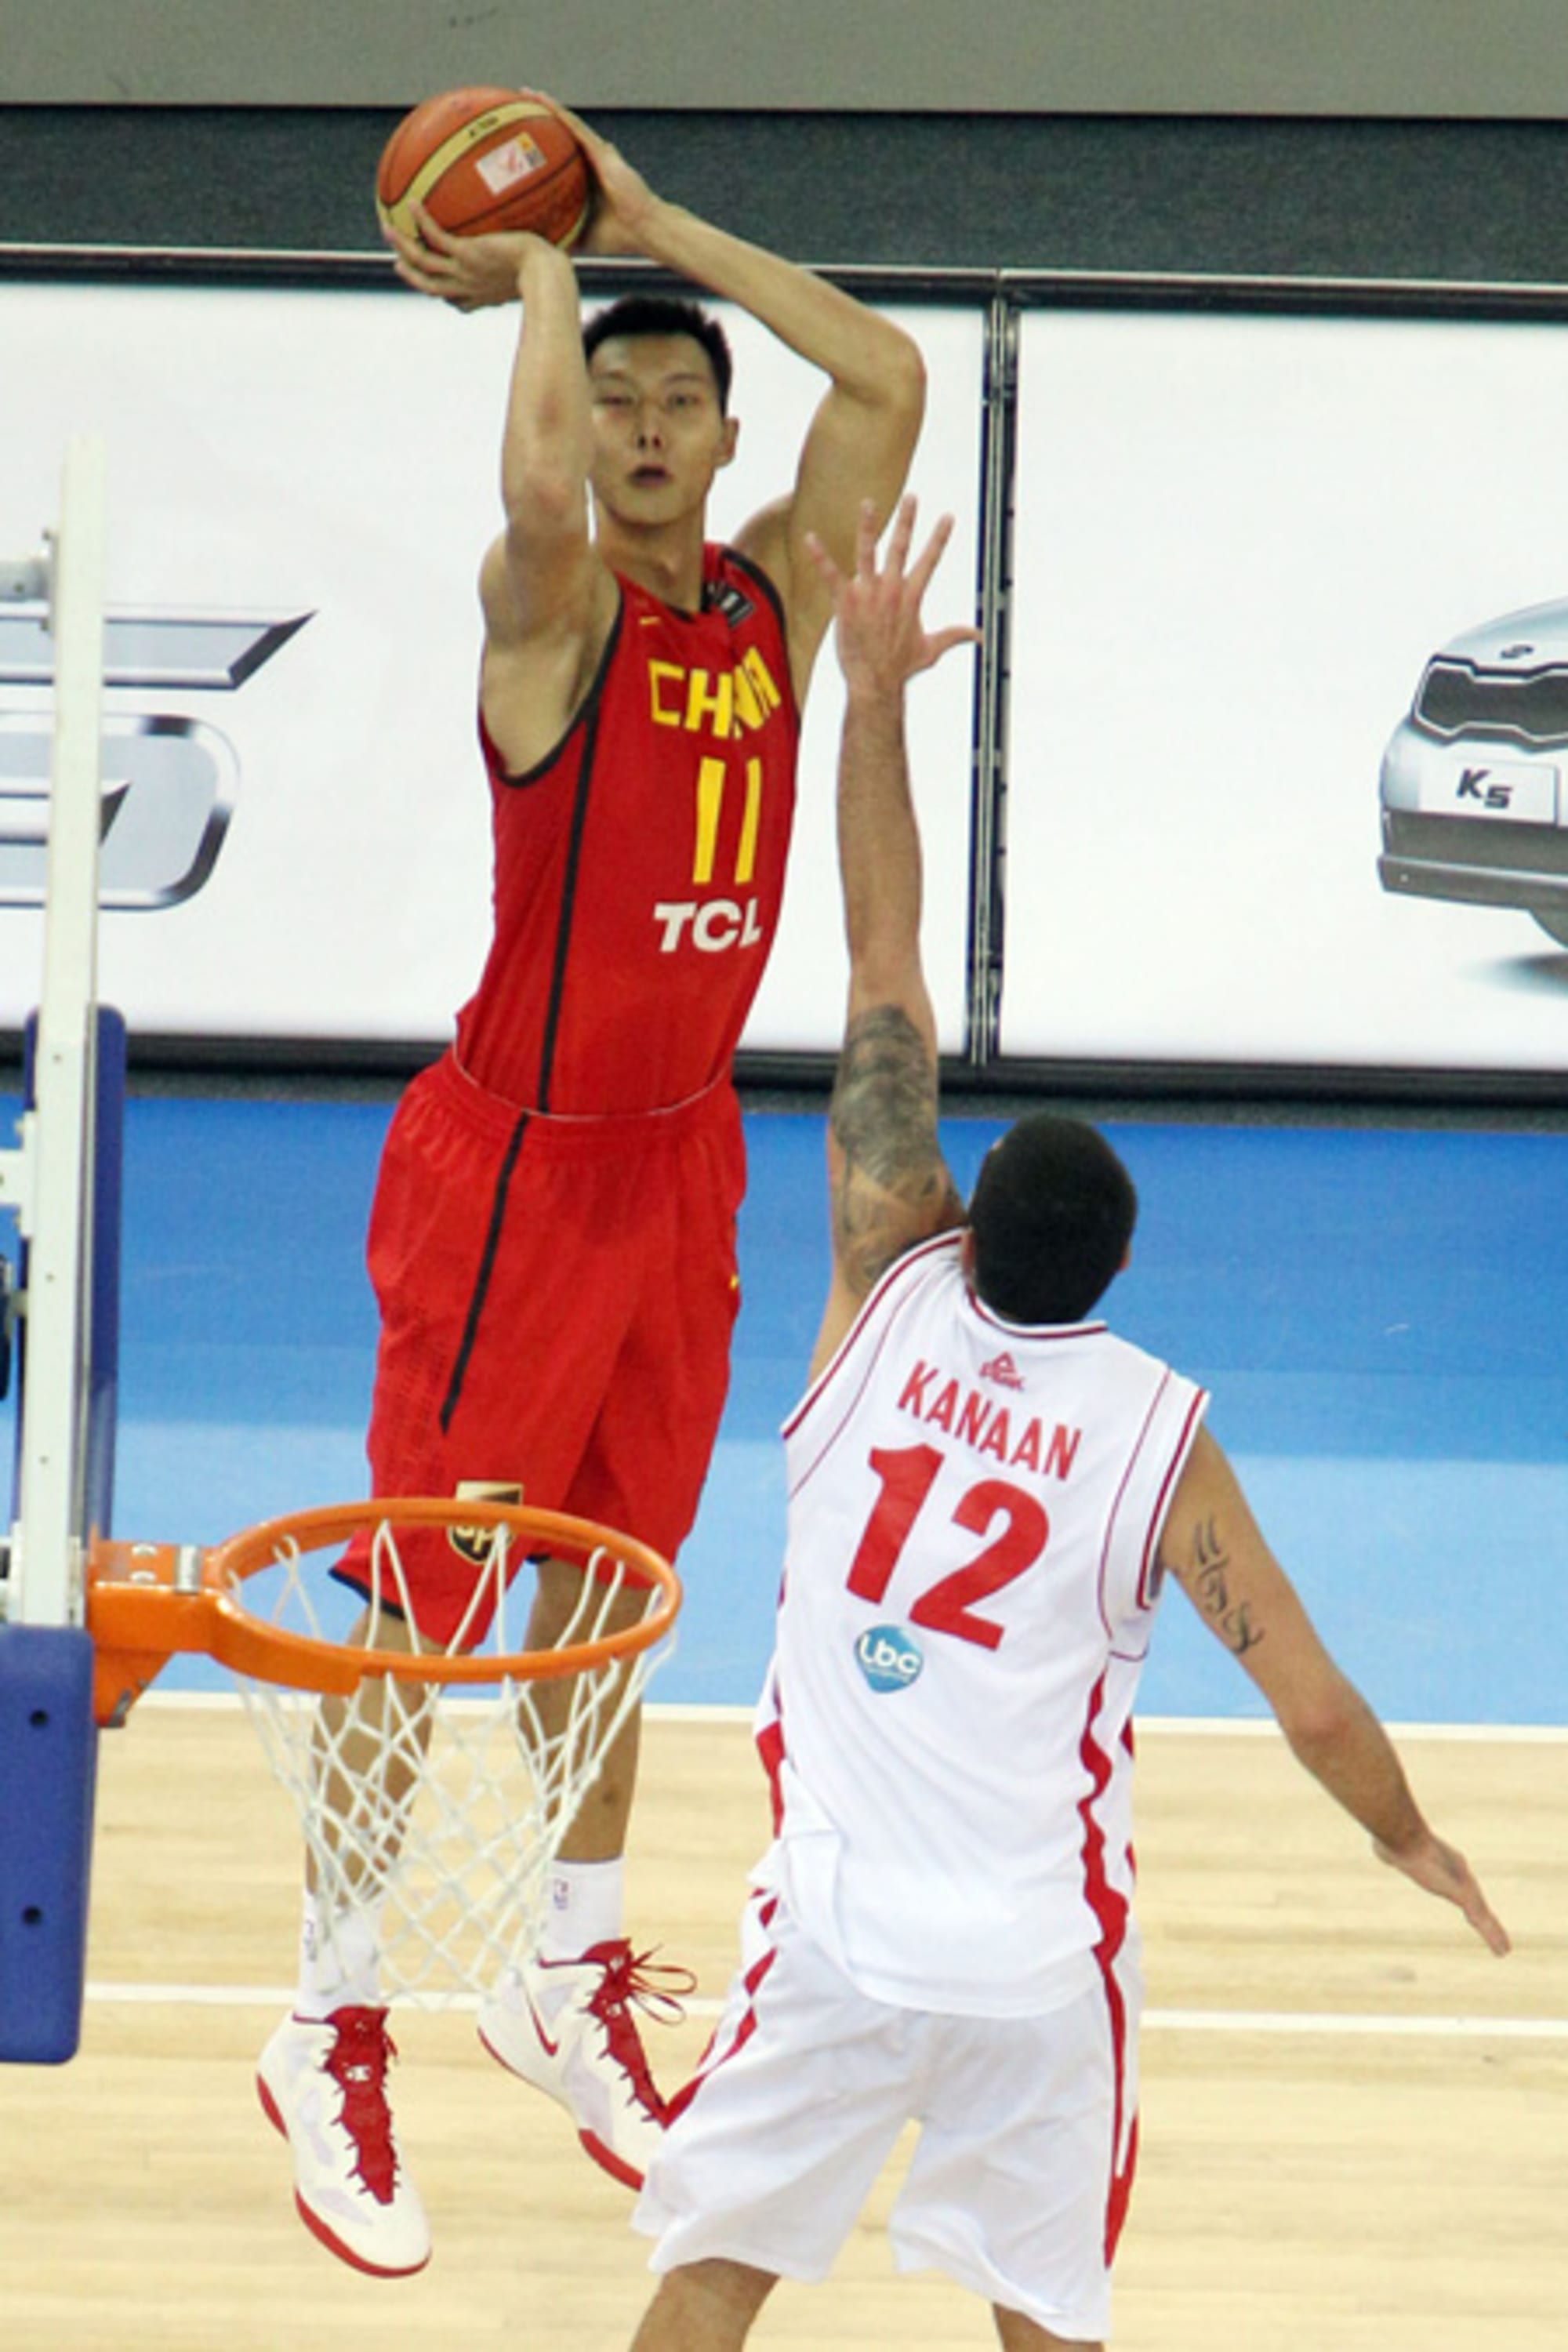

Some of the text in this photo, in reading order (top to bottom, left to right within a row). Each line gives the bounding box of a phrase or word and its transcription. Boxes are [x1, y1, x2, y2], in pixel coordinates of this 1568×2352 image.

[692, 755, 762, 885] 11
[652, 897, 764, 953] TCL
[896, 1356, 1083, 1482] KANAAN
[844, 1441, 1051, 1653] 12
